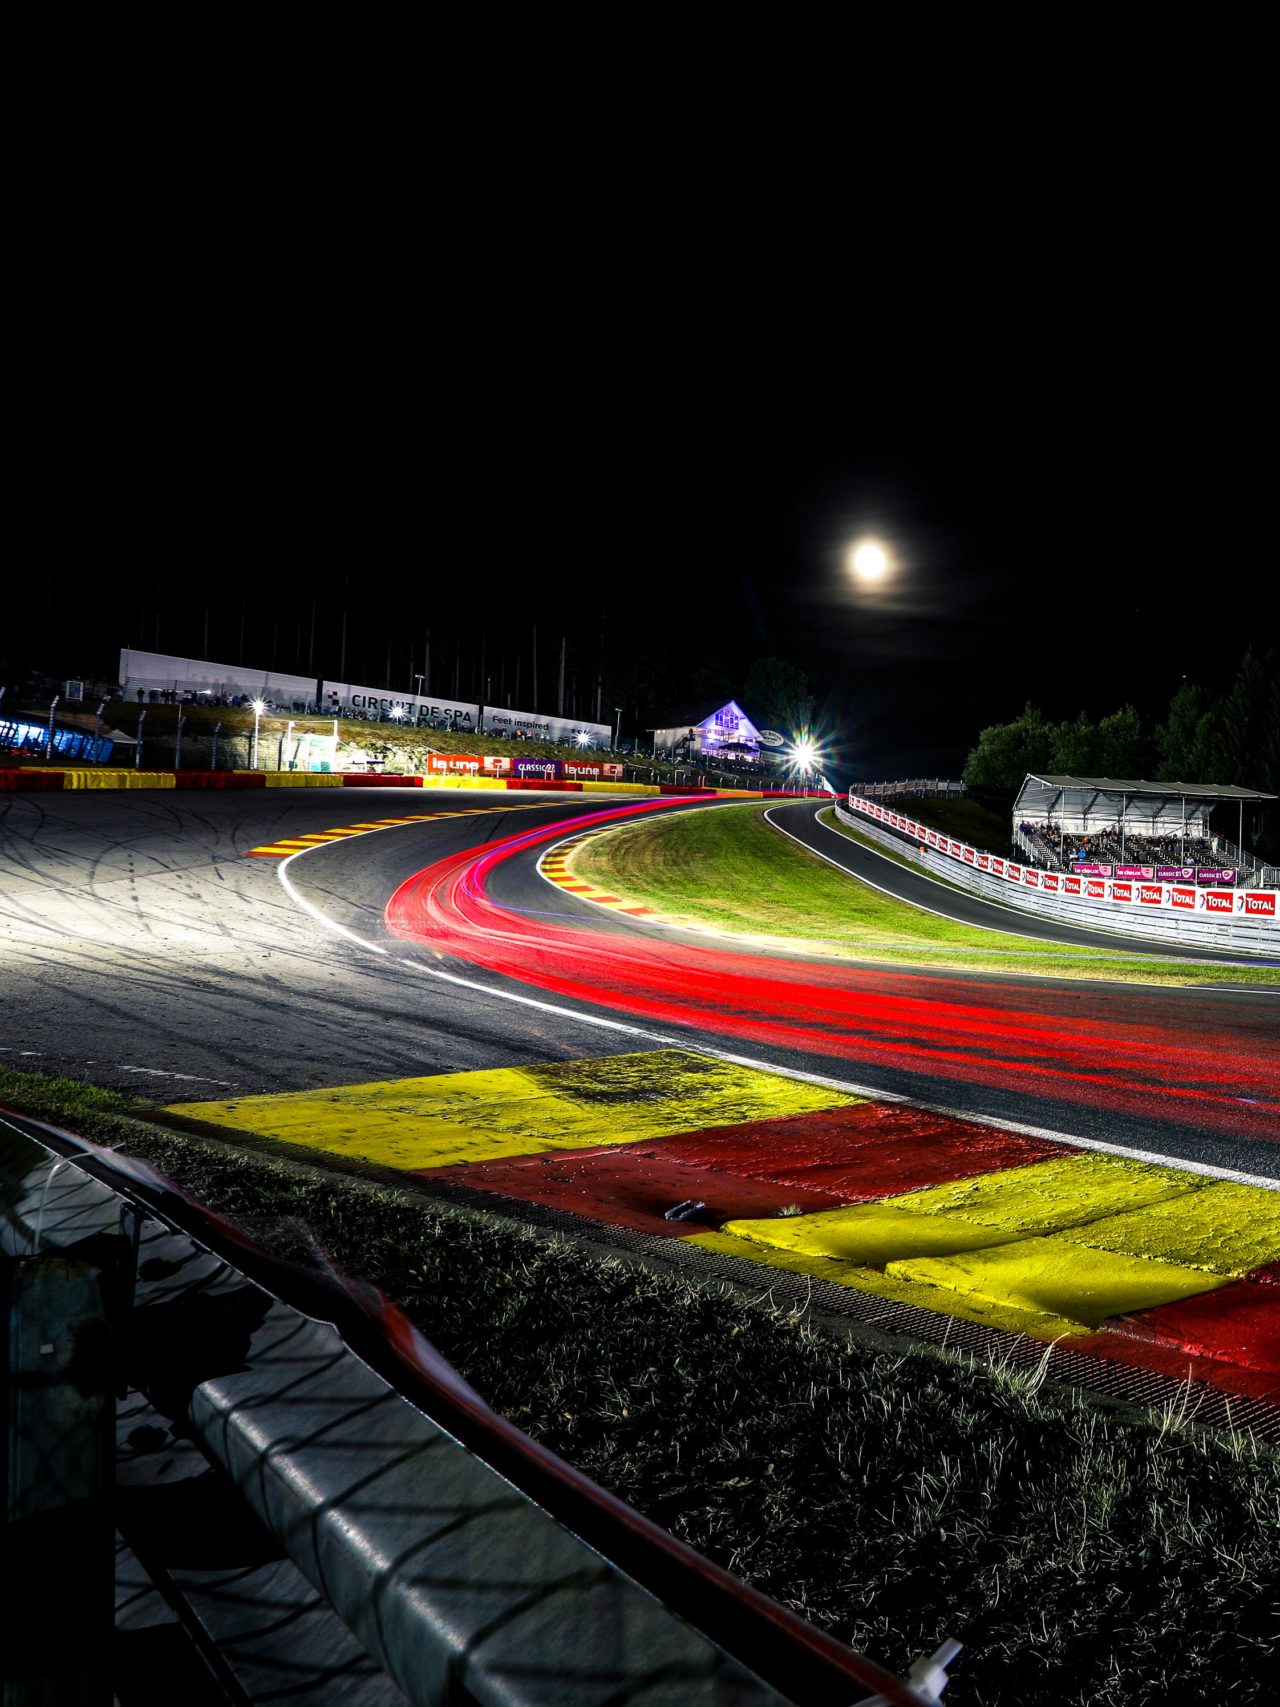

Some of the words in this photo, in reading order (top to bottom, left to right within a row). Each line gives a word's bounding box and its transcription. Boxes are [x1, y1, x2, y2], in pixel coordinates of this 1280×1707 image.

[420, 705, 439, 718] DE
[444, 709, 472, 723] SPA
[493, 716, 511, 726] Feel
[514, 718, 549, 731] inspired
[1065, 881, 1080, 891] TOTAL
[1088, 884, 1104, 894] TOTAL
[1114, 888, 1131, 897] TOTAL
[1141, 888, 1162, 901] TOTAL
[1173, 892, 1195, 904] TOTAL
[1208, 895, 1232, 908] TOTAL
[1247, 898, 1274, 911] TOTAL
